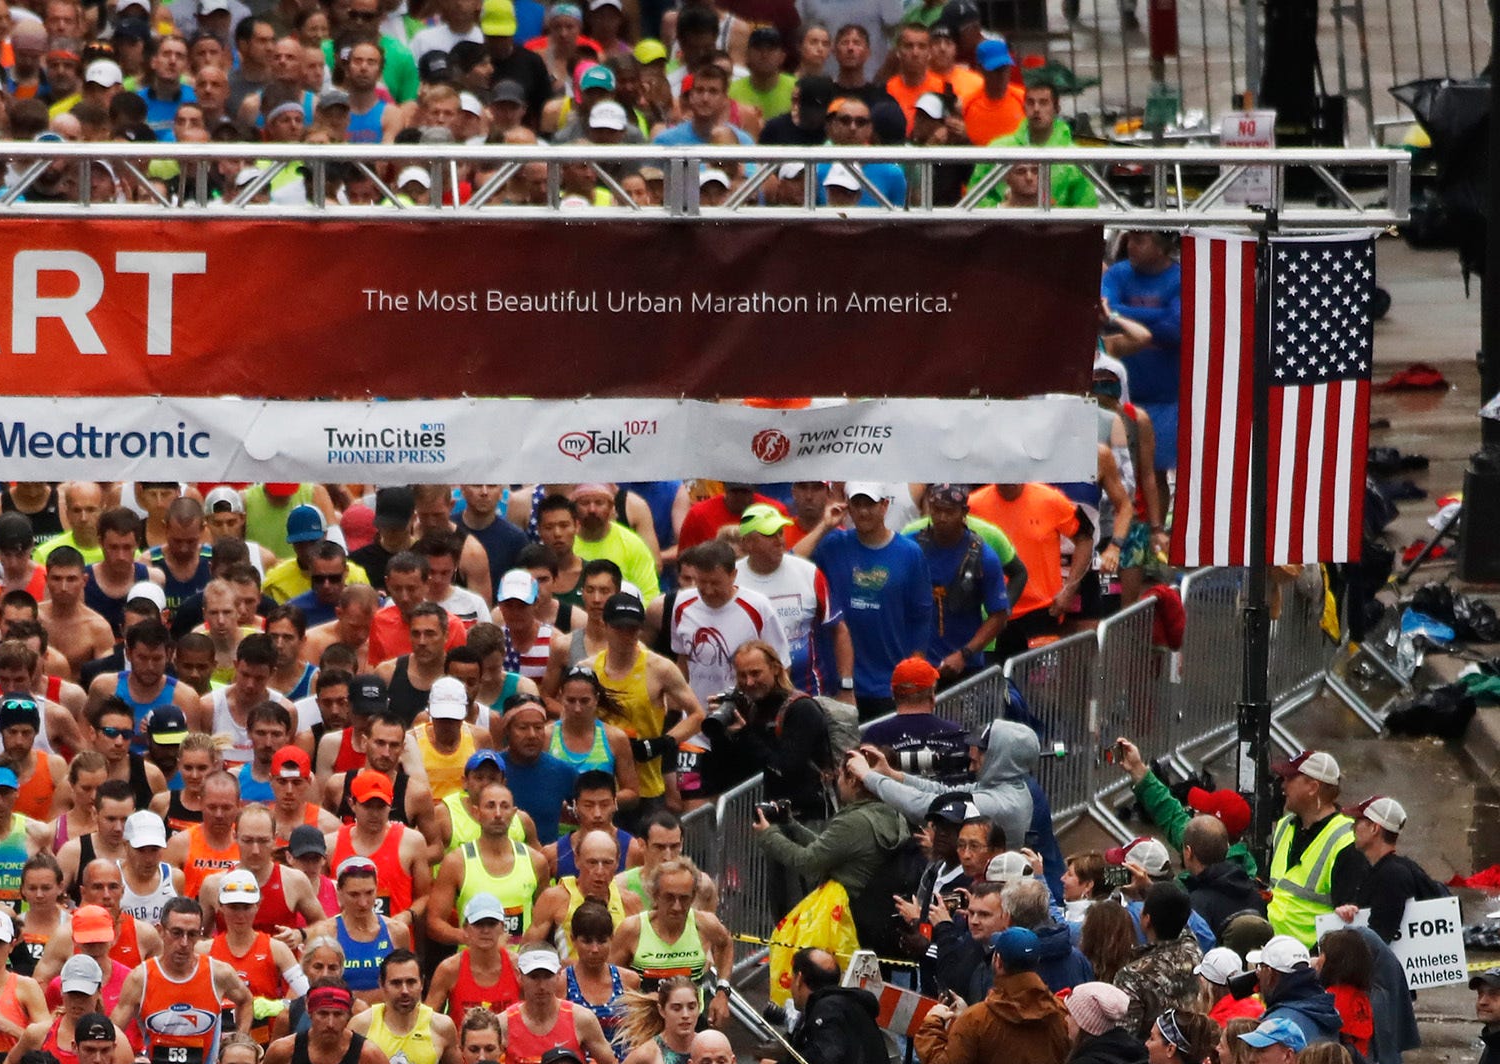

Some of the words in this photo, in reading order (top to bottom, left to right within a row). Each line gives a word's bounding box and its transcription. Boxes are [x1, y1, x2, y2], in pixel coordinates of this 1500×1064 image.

[1238, 119, 1256, 137] NO
[362, 289, 410, 313] The
[417, 290, 478, 314] Most
[485, 289, 600, 314] Beautiful
[606, 291, 682, 314] Urban
[690, 290, 809, 315] Marathon
[816, 291, 838, 314] in
[623, 420, 658, 436] 107.1
[797, 427, 841, 443] TWIN
[842, 423, 893, 443] CITIES
[323, 427, 446, 449] TwinCities
[796, 441, 815, 457] IN
[818, 439, 884, 457] MOTION
[327, 450, 395, 465] PIONEER
[398, 450, 446, 464] PRESS
[1407, 918, 1455, 939] FOR:
[654, 950, 700, 960] BROOKS
[1405, 953, 1459, 970] Athletes
[1410, 968, 1464, 986] Athletes
[168, 1047, 188, 1063] 53
